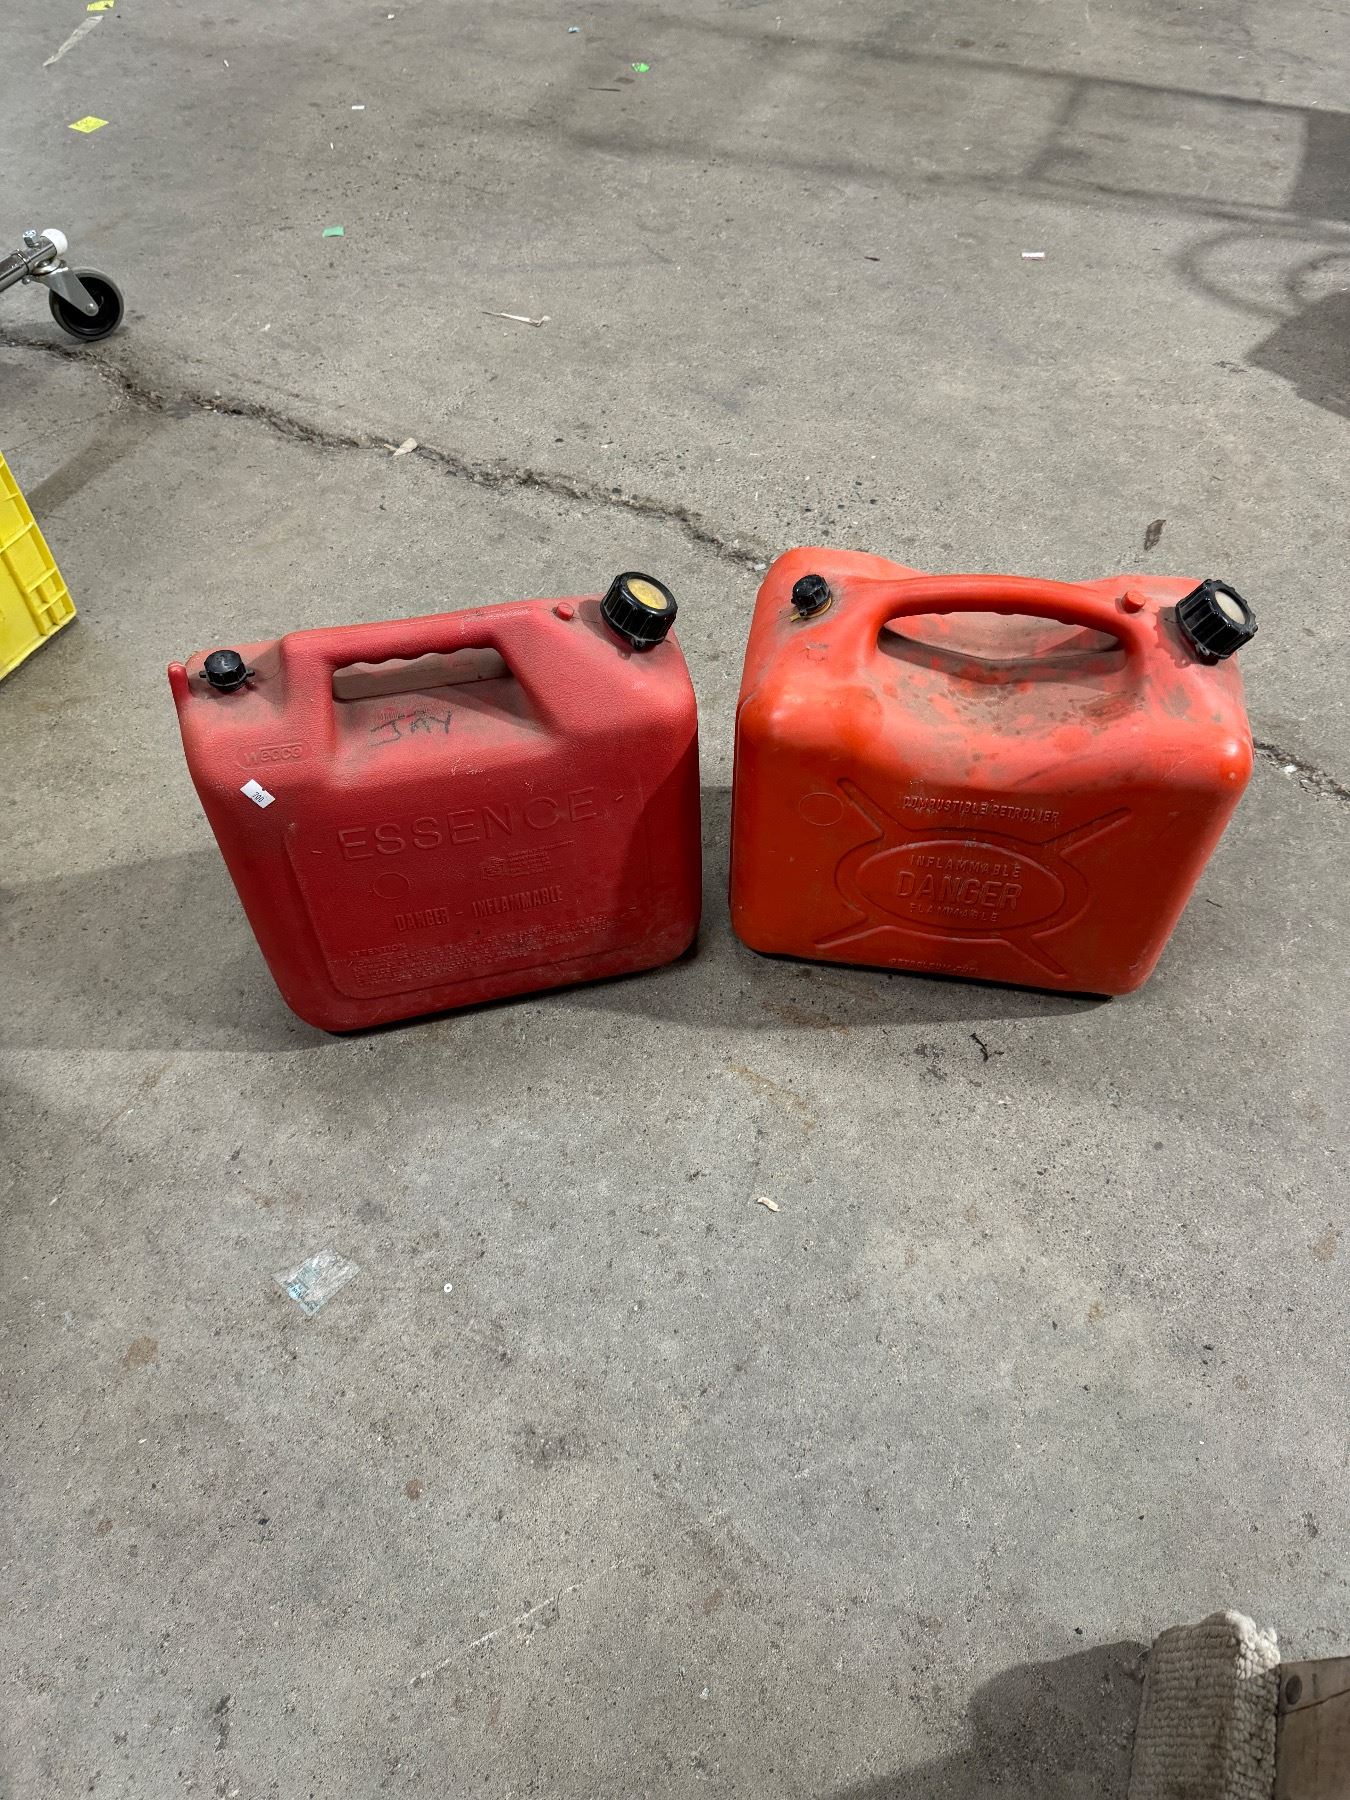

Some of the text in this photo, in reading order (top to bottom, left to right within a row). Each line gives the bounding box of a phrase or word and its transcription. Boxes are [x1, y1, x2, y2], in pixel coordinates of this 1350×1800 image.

[337, 786, 598, 862] ESSENCE
[910, 854, 1021, 878] INFLAMMABLE
[897, 870, 1022, 910] DANGER
[394, 906, 450, 932] DANGER
